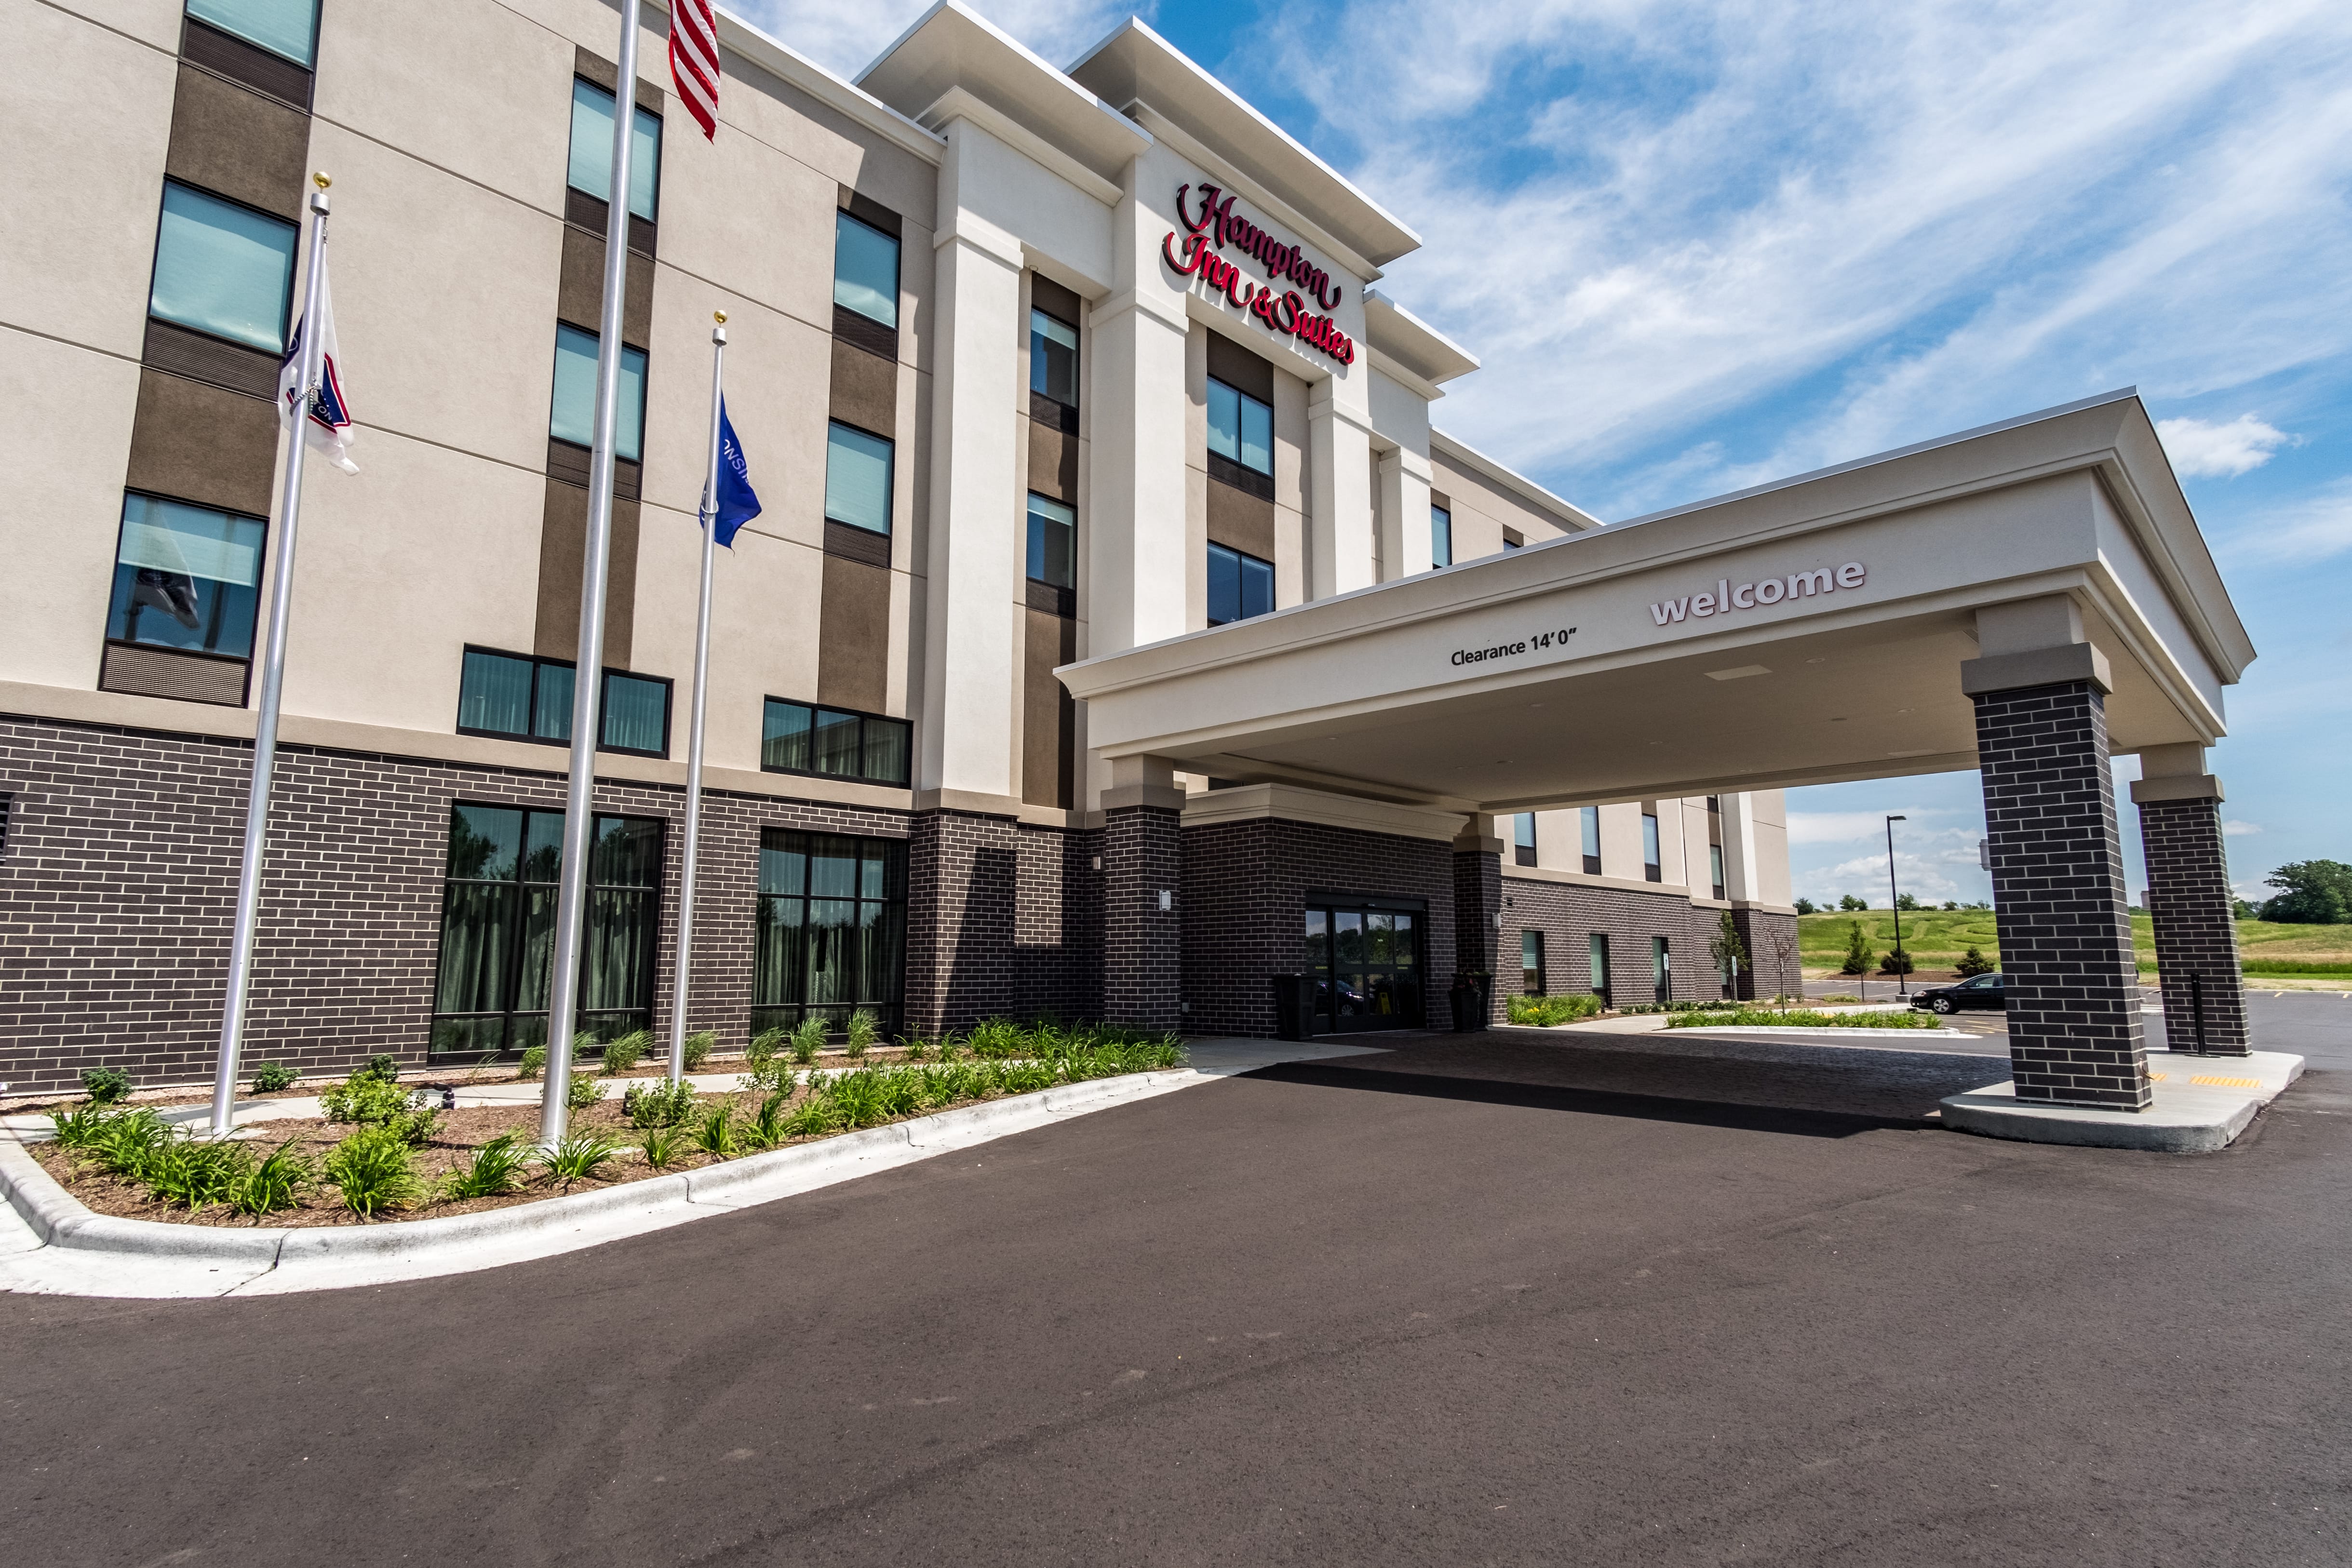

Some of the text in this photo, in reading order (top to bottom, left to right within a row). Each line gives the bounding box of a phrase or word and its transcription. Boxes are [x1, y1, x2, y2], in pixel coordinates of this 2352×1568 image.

[1176, 183, 1342, 311] Hampton
[1162, 231, 1254, 308] Inn
[1271, 290, 1355, 366] Suites
[1650, 562, 1865, 626] welcome
[1451, 642, 1526, 666] Clearance
